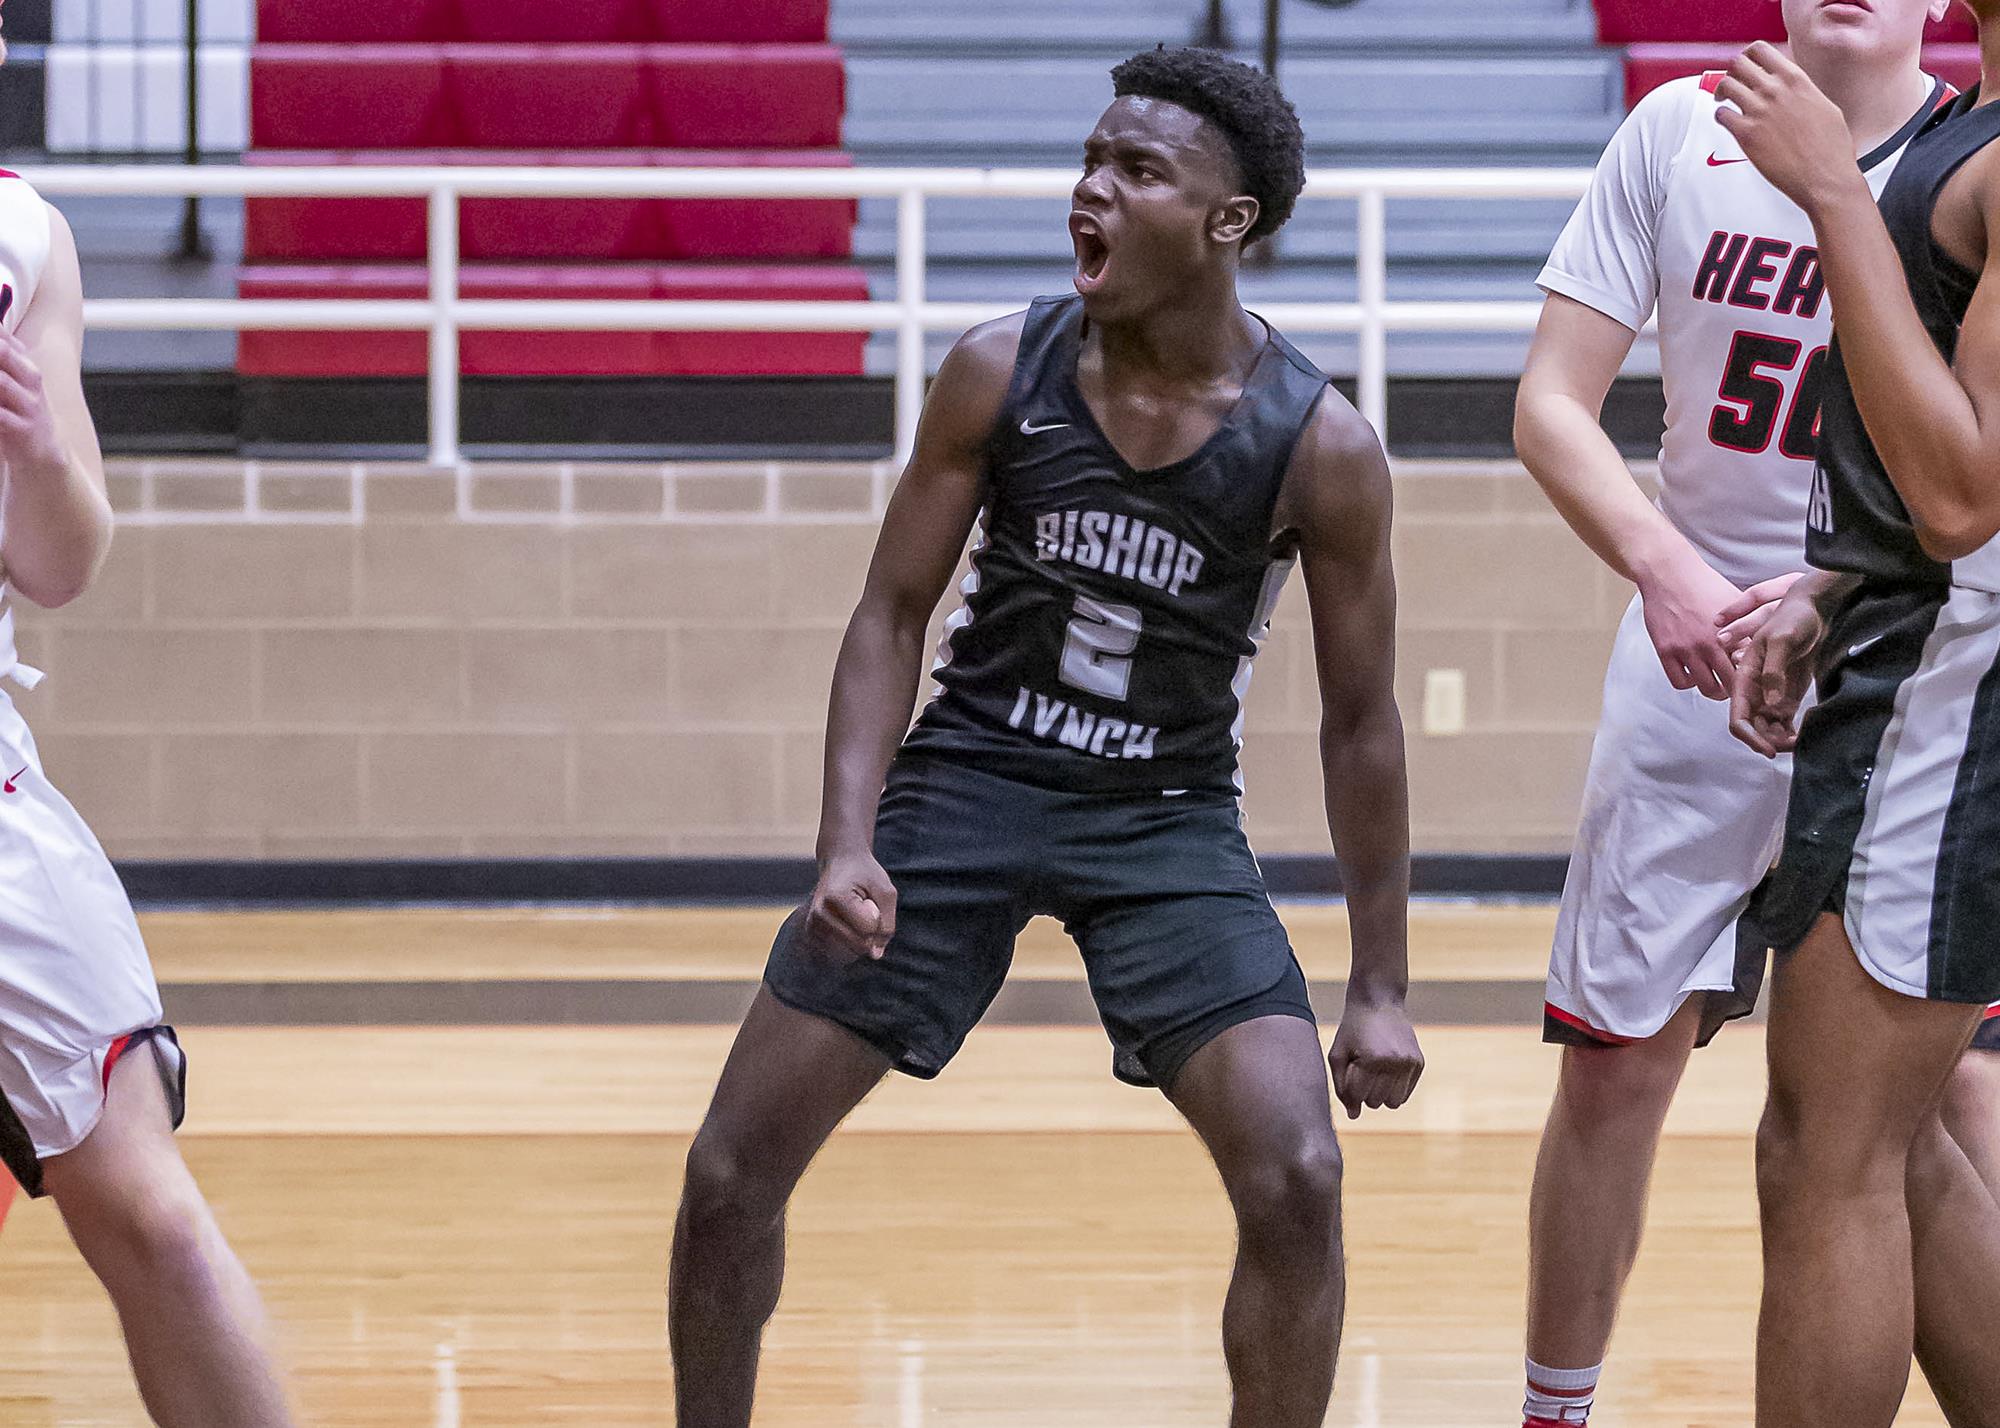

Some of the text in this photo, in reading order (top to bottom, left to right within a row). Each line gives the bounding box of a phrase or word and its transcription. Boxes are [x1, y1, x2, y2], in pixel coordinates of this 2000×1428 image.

[1692, 230, 1828, 319] HEA
[1035, 510, 1205, 597] BISHOP
[1058, 595, 1143, 701] 2
